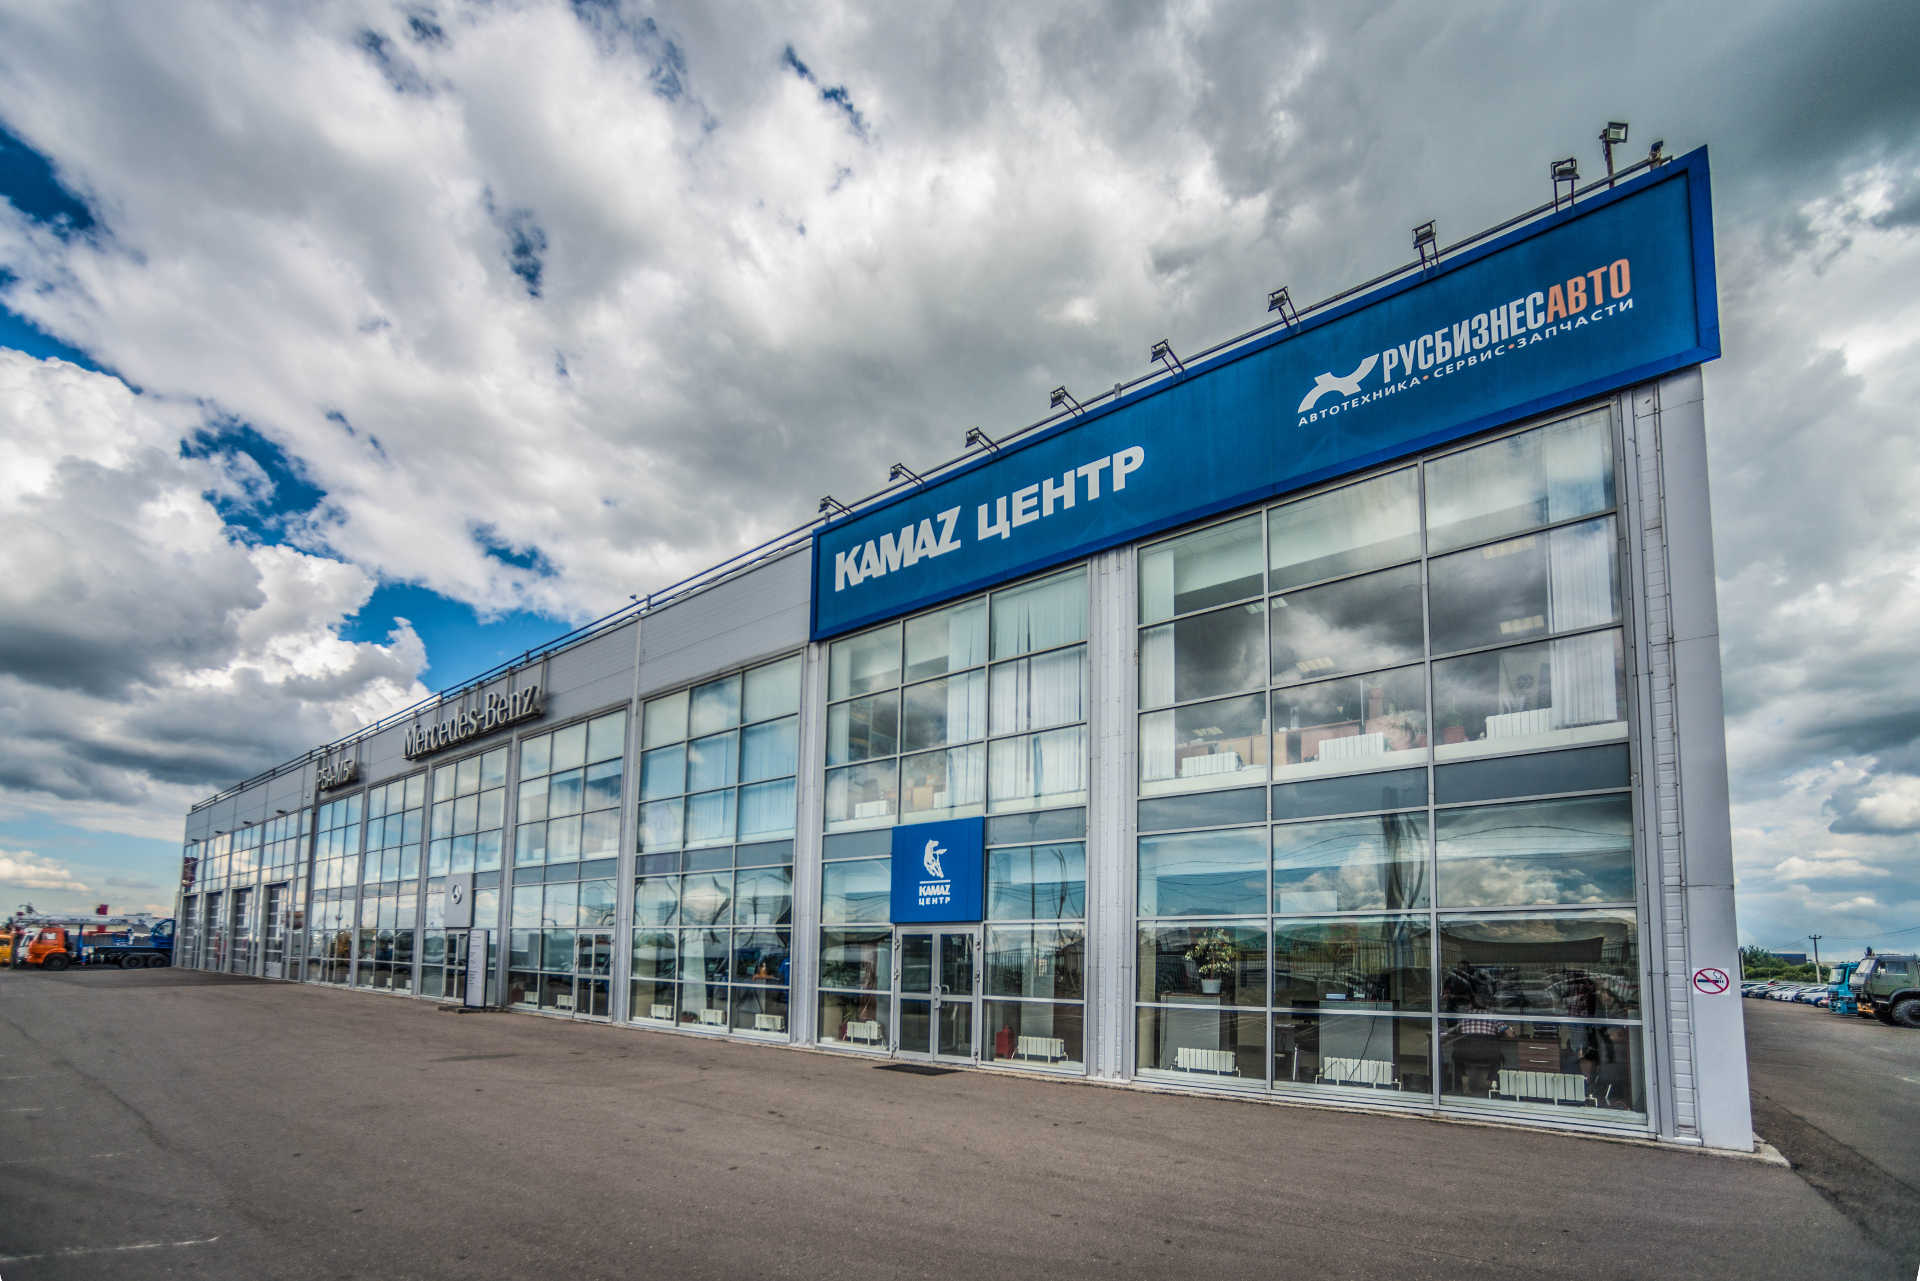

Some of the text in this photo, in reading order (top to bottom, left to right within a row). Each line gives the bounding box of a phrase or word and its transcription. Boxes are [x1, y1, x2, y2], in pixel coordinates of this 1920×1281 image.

[1382, 257, 1632, 384] РУСБИЗНЕСАВТО
[835, 445, 1145, 592] KAMAZ ЦЕНТР
[402, 684, 539, 757] Mercedes-Benz
[918, 884, 951, 897] KAMAZ
[918, 896, 951, 906] ЦЕНТР
